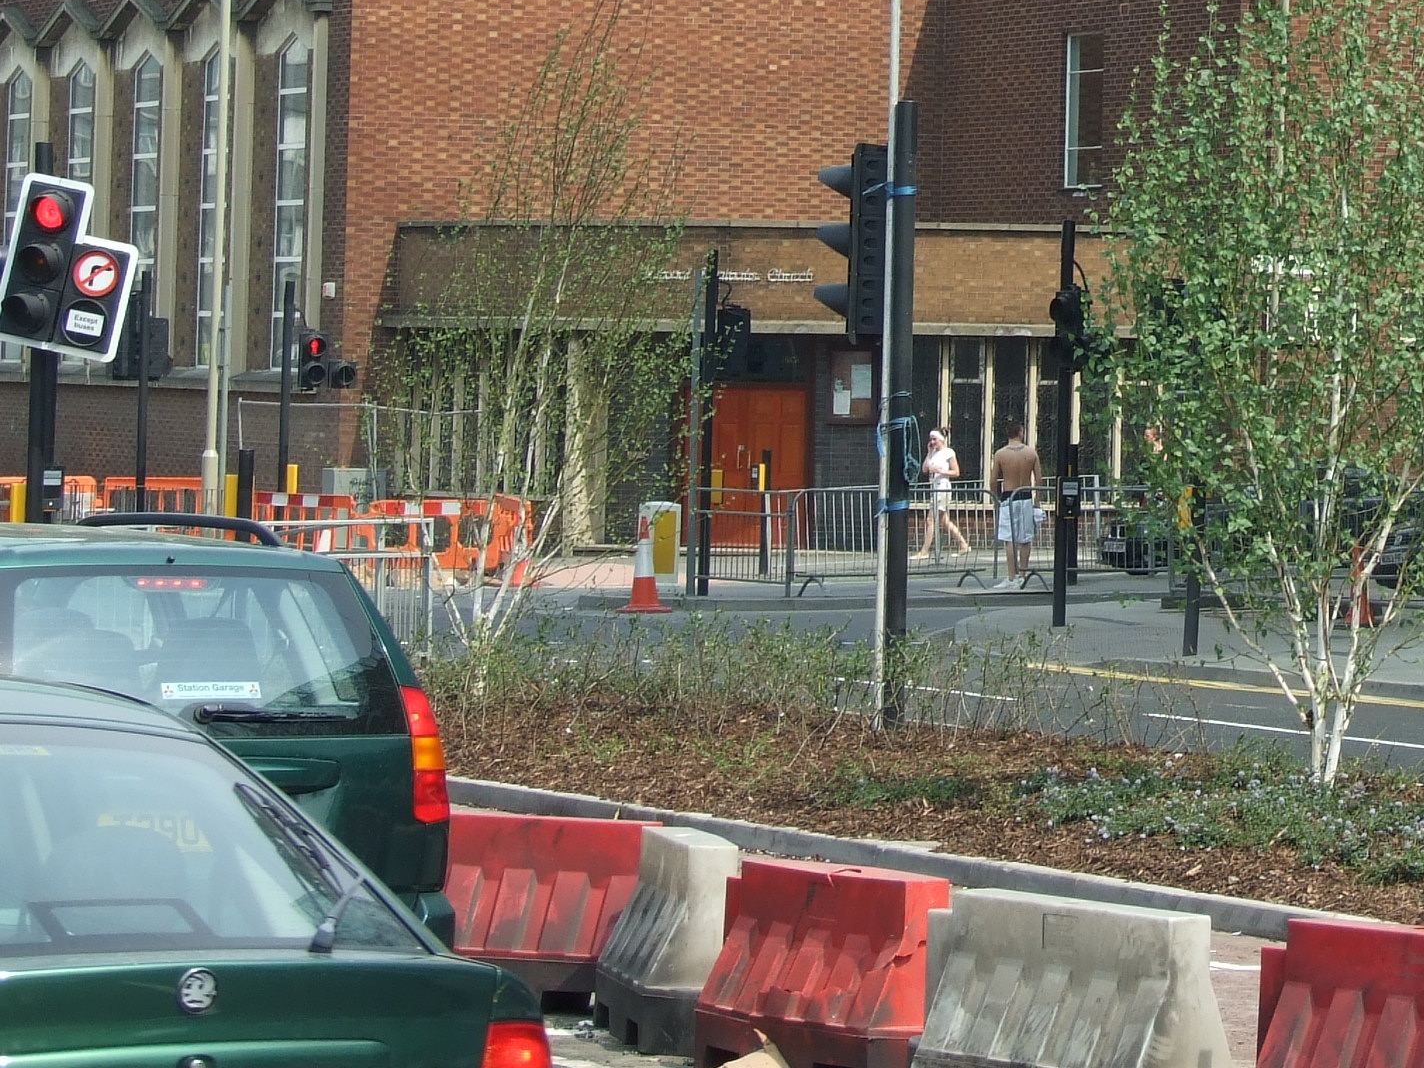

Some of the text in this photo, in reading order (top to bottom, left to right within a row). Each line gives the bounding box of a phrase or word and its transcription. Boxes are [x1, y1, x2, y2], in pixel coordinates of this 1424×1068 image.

[74, 314, 99, 325] Except
[73, 322, 95, 332] buses
[177, 683, 245, 693] Station Garage
